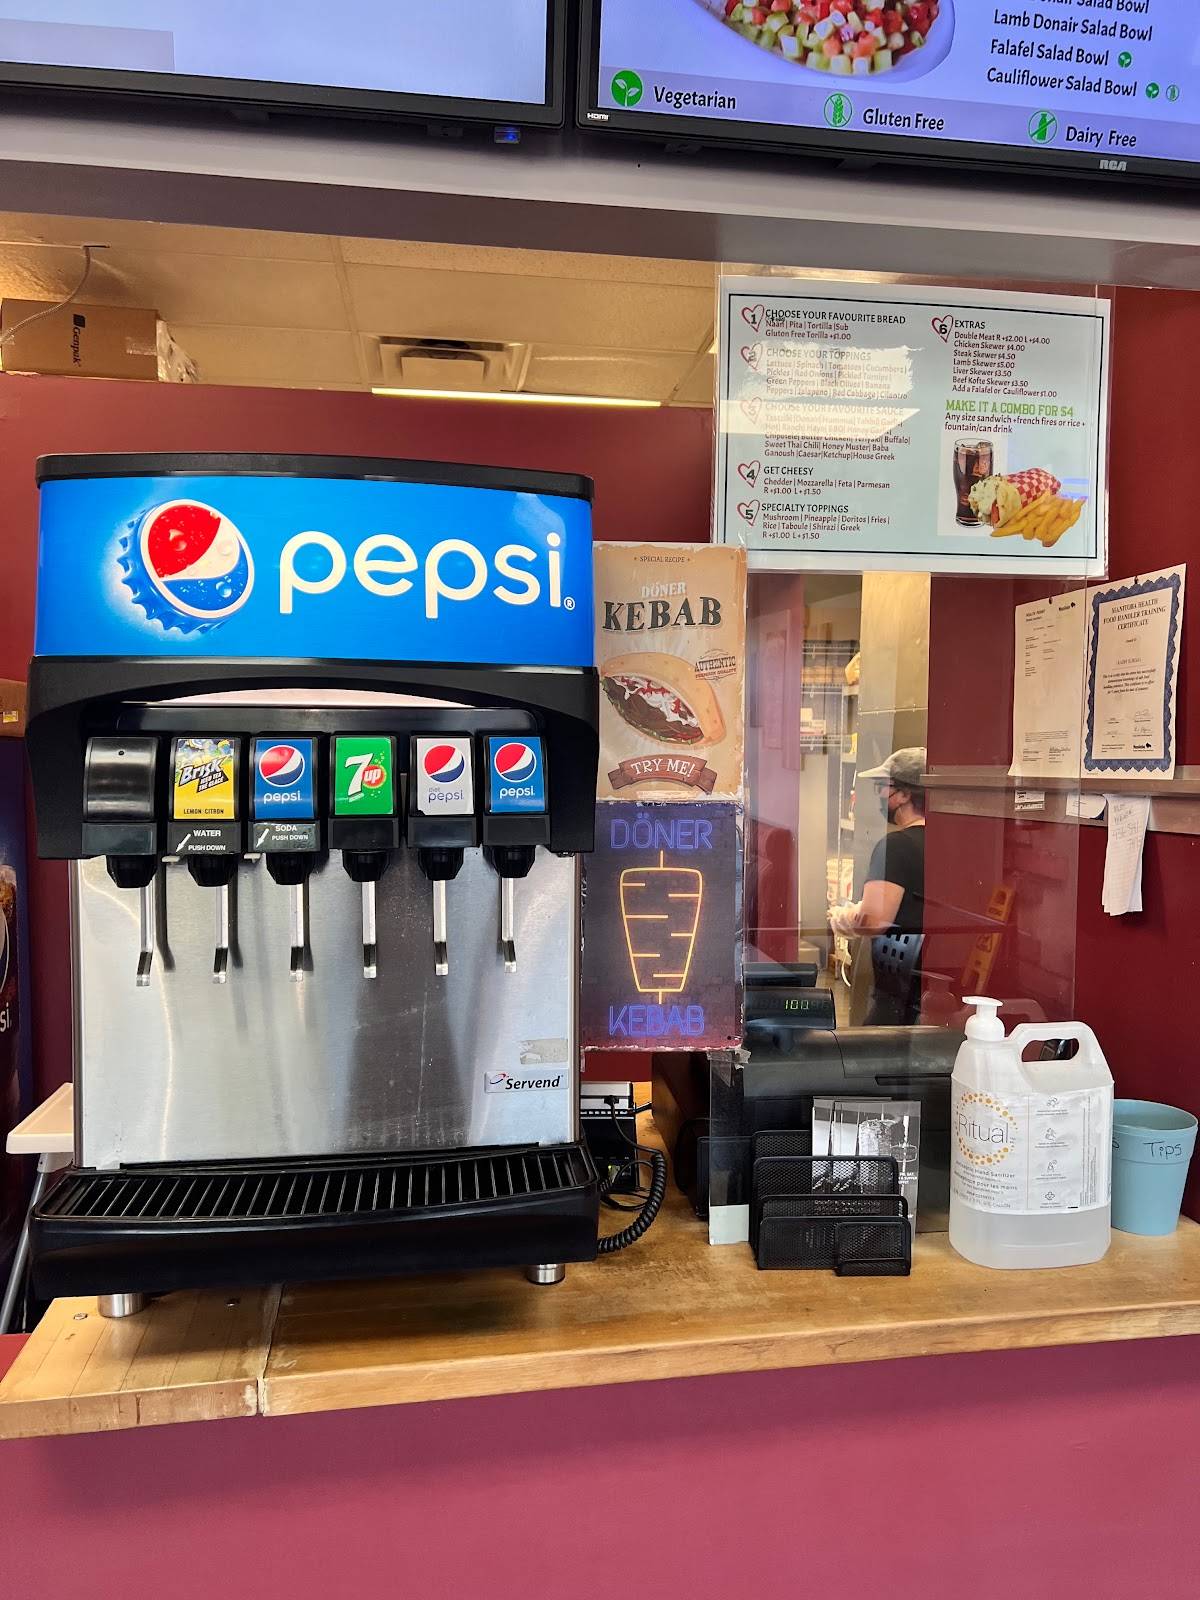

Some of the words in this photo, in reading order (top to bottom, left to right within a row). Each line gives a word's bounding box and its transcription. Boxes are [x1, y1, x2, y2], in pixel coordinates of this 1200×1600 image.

[1116, 0, 1149, 13] Bowl
[994, 9, 1030, 27] Lamb
[1033, 13, 1079, 33] Donair
[1080, 19, 1116, 37] Salad
[1119, 25, 1153, 41] Bowl
[990, 39, 1034, 57] Falafel
[1036, 44, 1073, 62] Salad
[1075, 48, 1109, 66] Bowl
[987, 67, 1064, 89] Cauliflower
[1065, 75, 1102, 93] Salad
[1104, 80, 1137, 97] Bowl
[653, 85, 737, 111] Vegetarian
[862, 108, 910, 130] Gluten
[913, 113, 945, 132] Free
[1065, 126, 1103, 149] Dairy
[1107, 130, 1137, 149] Free
[1099, 159, 1128, 172] RCA
[750, 314, 757, 324] 1
[765, 309, 801, 319] CHOOSE
[802, 311, 826, 320] YOUR
[828, 312, 875, 323] FAVOURITE
[877, 315, 906, 324] BREAD
[789, 321, 803, 329] Pita
[807, 322, 832, 330] Tortilla
[939, 324, 948, 335] 6
[954, 319, 986, 329] EXTRAS
[791, 330, 806, 338] Free
[954, 332, 978, 340] Double
[978, 333, 995, 341] Meat
[995, 334, 1001, 342] R
[71, 326, 81, 363] Genpak
[953, 340, 980, 349] Chicken
[980, 342, 1006, 351] Skewer
[1006, 344, 1026, 352] $4.00
[766, 348, 802, 358] CHOOSE
[803, 350, 828, 359] YOUR
[830, 350, 872, 360] TOPPINGS
[953, 350, 972, 358] Steak
[973, 350, 998, 359] Skewer
[998, 352, 1016, 360] $4.50
[953, 358, 972, 366] Lamb
[972, 359, 997, 368] Skewer
[997, 361, 1015, 369] $5.00
[953, 367, 969, 375] Liver
[969, 368, 994, 377] Skewer
[994, 370, 1012, 378] $3.50
[952, 376, 968, 384] Beef
[968, 377, 986, 385] Kofte
[986, 378, 1011, 387] Skewer
[1011, 380, 1029, 388] $3.50
[952, 384, 966, 393] Add
[971, 386, 993, 394] Falafel
[1002, 387, 1040, 397] Cauliflower
[945, 400, 976, 412] MAKE
[978, 401, 990, 413] IT
[991, 403, 999, 413] A
[1000, 402, 1036, 415] COMBO
[1038, 404, 1059, 417] FOR
[1060, 405, 1074, 417] $4
[945, 413, 961, 422] Any
[961, 414, 976, 422] size
[976, 414, 1012, 424] sandwich
[1041, 417, 1057, 426] fires
[1067, 418, 1081, 427] rice
[944, 422, 992, 433] fountain/can
[992, 424, 1013, 433] drink
[764, 440, 786, 448] Sweet
[787, 441, 803, 449] Thai
[822, 442, 845, 452] Honey
[872, 444, 889, 452] Baba
[764, 449, 794, 457] Ganoush
[874, 453, 895, 461] Greek
[746, 469, 756, 479] 4
[763, 466, 780, 475] GET
[781, 467, 814, 476] CHEESY
[763, 478, 793, 486] Chedder
[797, 479, 834, 488] Mozzarella
[838, 480, 853, 488] Feta
[857, 481, 890, 489] Parmesan
[745, 509, 754, 520] 5
[761, 503, 806, 513] SPECIALTY
[807, 505, 849, 513] TOPPINGS
[763, 514, 800, 522] Mushroom
[804, 515, 838, 524] Pineapple
[841, 516, 867, 524] Doritos
[782, 523, 808, 531] Taboule
[812, 523, 836, 531] Shirazi
[279, 530, 562, 619] pepsi
[602, 596, 722, 632] KEBAB
[694, 655, 737, 672] AUTHENTIC
[179, 757, 223, 786] Brisk
[630, 759, 663, 776] TRY
[666, 759, 696, 778] ME!
[263, 790, 302, 804] pepsi
[428, 789, 463, 804] pepsi
[500, 785, 534, 799] pepsi
[193, 829, 222, 837] WATER
[610, 811, 713, 850] DÖNER
[608, 1005, 705, 1037] KEBAB
[505, 1075, 561, 1090] Servend
[957, 1112, 1009, 1144] Ritual
[1142, 1141, 1182, 1160] Tips
